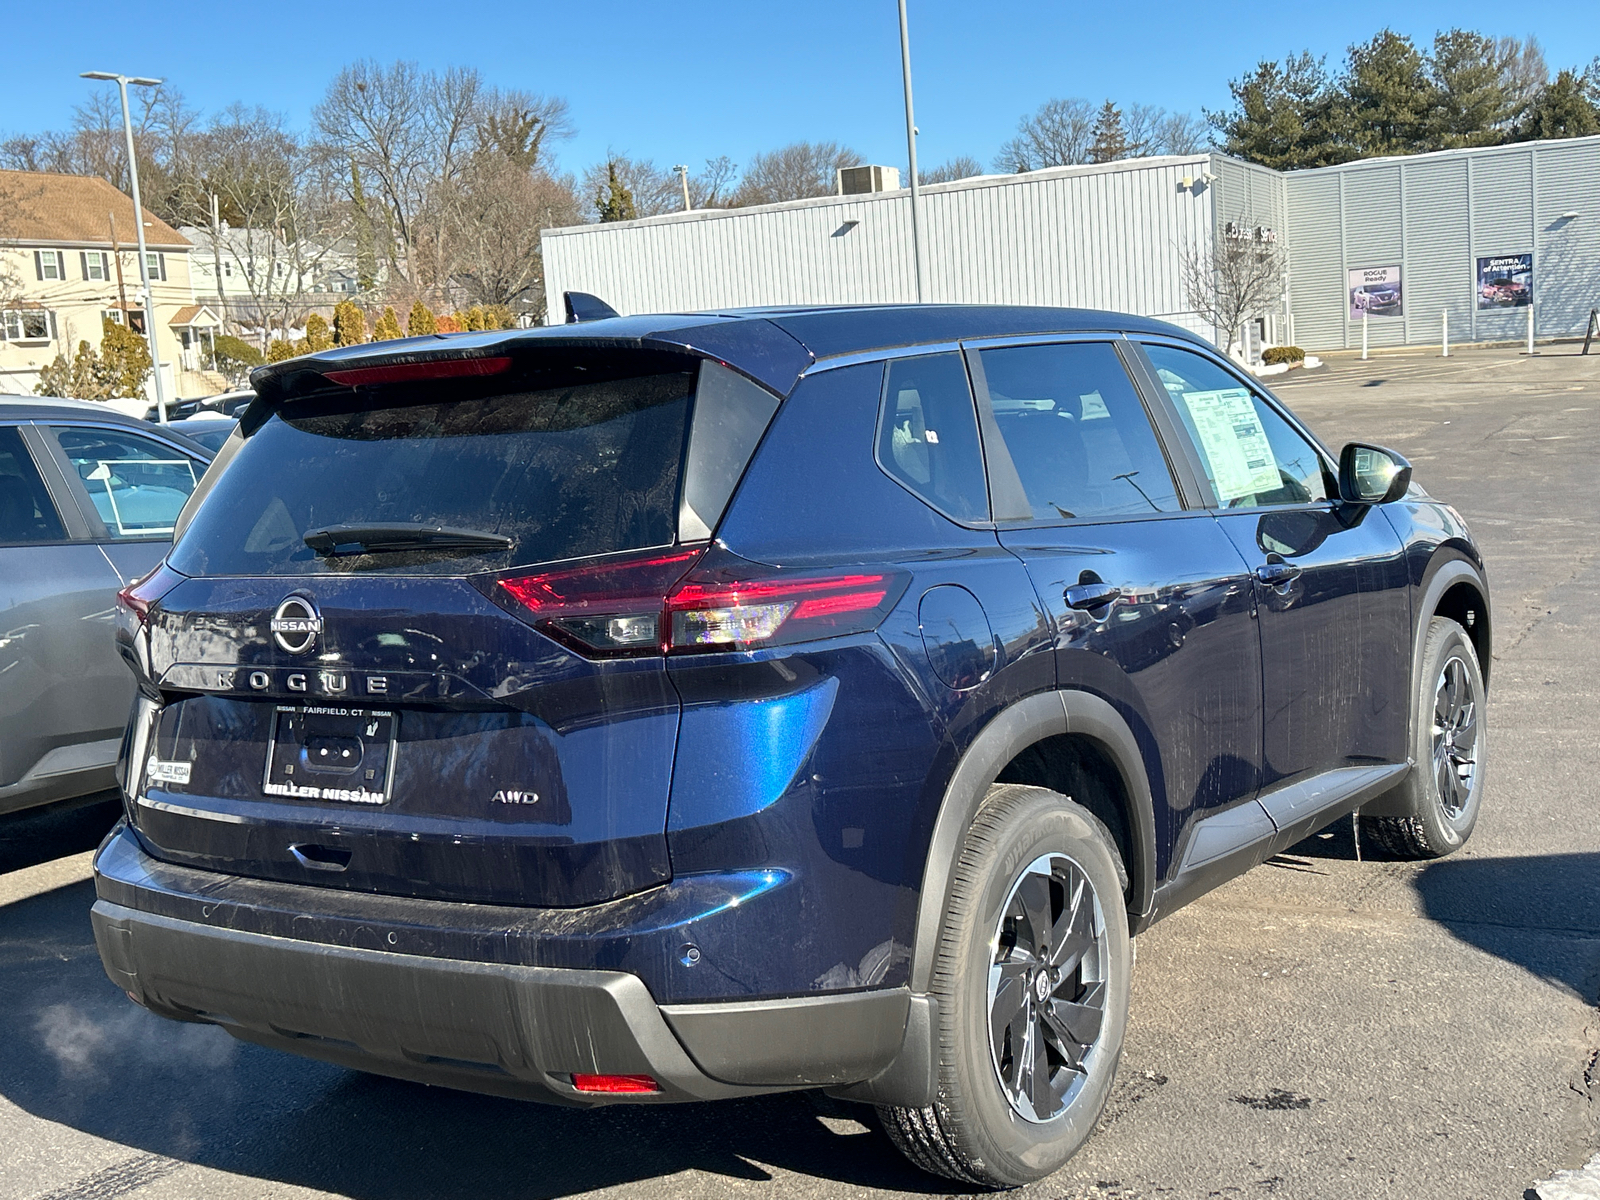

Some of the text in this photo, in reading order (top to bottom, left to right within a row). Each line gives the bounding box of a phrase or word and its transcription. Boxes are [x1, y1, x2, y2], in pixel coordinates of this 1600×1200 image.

[1490, 258, 1519, 266] SENTRA
[271, 620, 318, 632] NISSAN
[218, 670, 388, 695] ROGUE
[303, 706, 349, 717] FAIRFIELD,
[264, 783, 384, 804] MILLER NISSAN
[491, 790, 539, 804] AWD
